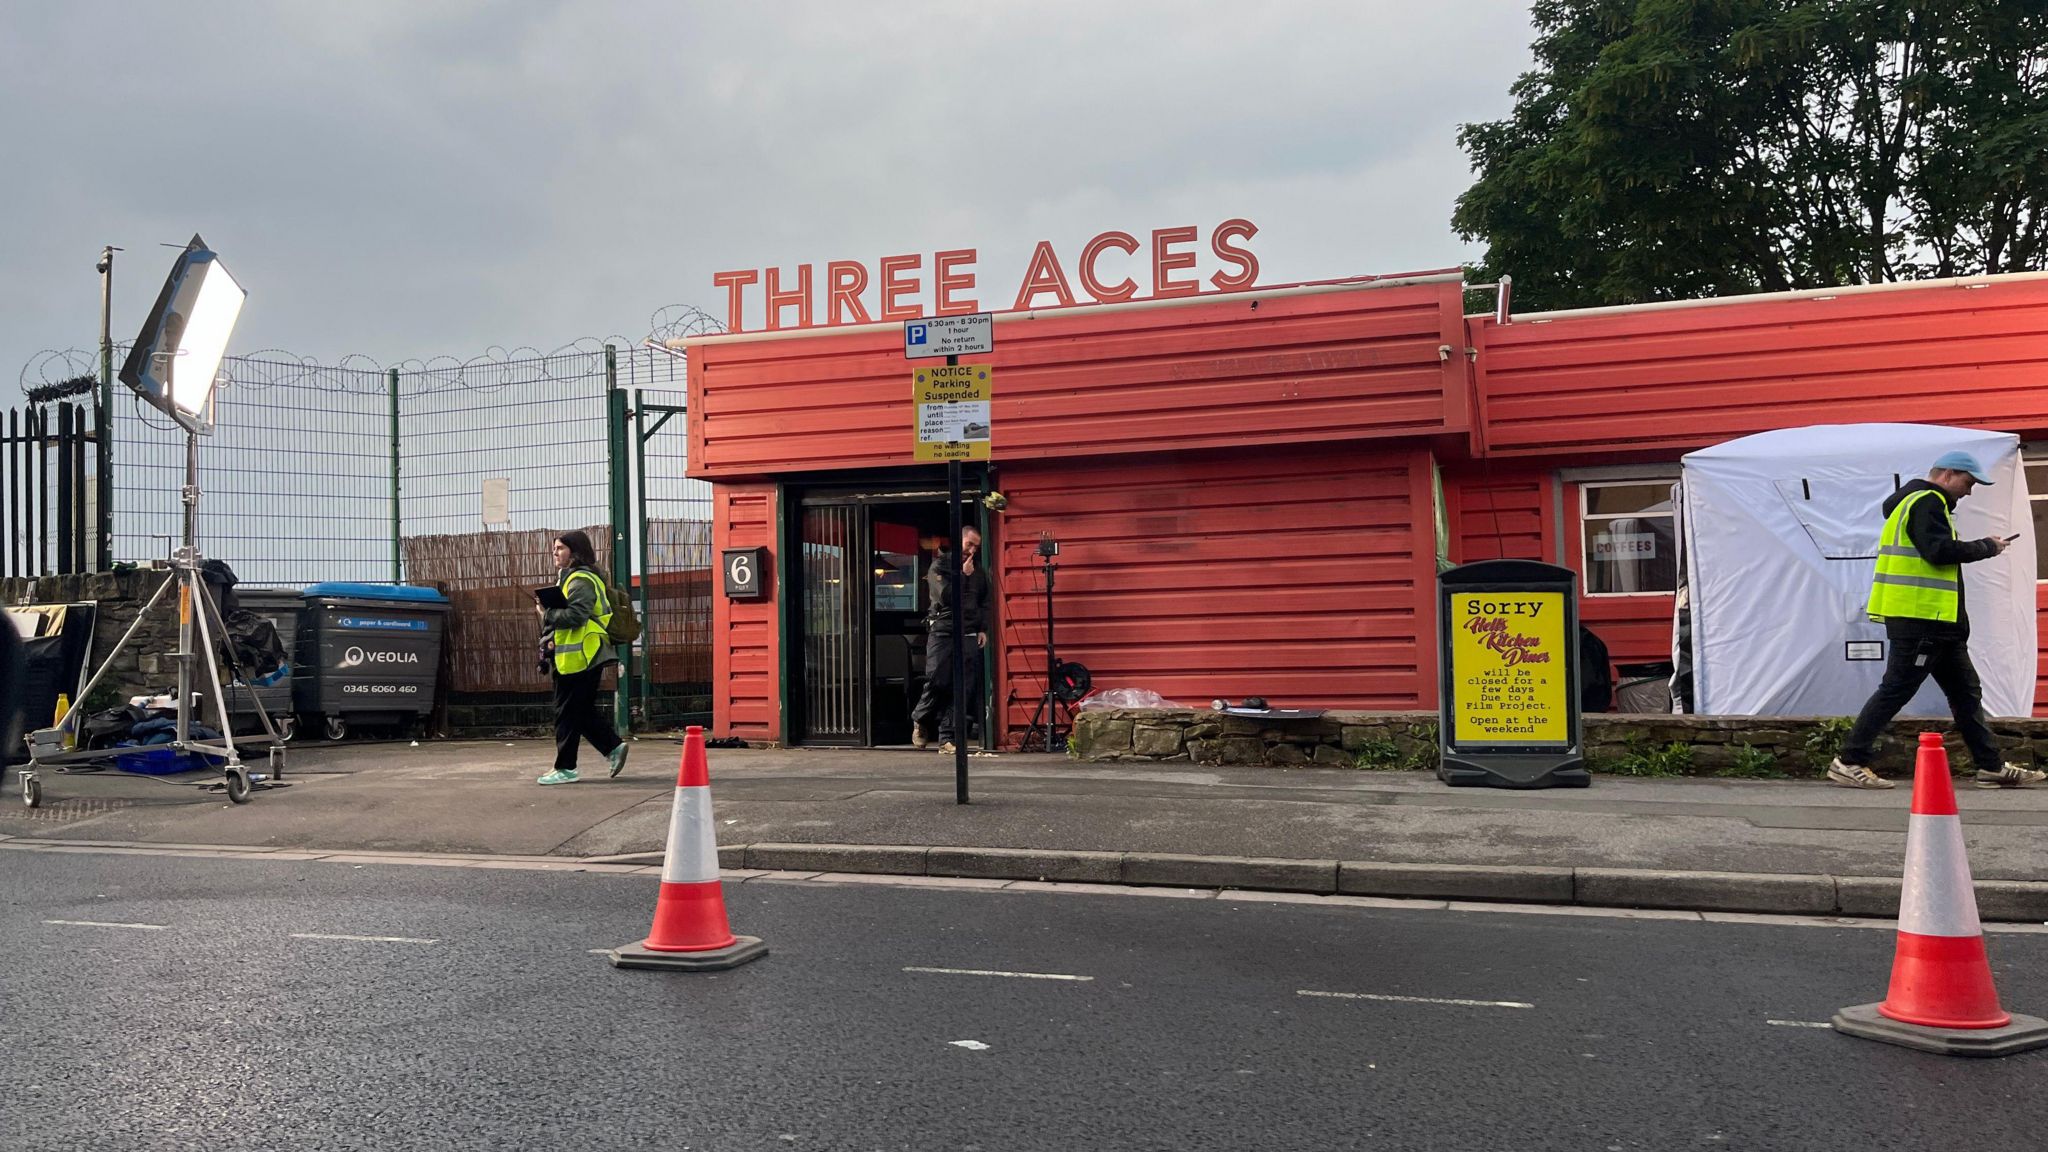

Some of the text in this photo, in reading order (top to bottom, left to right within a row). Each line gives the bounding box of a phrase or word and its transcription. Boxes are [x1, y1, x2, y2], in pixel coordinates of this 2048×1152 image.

[713, 218, 1259, 333] THREE ACES
[912, 326, 923, 344] P
[932, 367, 972, 377] NOTICE
[933, 379, 970, 388] Parking
[925, 390, 979, 401] Suspended
[731, 556, 751, 584] 6
[1468, 600, 1543, 617] Sorry
[1478, 632, 1541, 653] Kitchen
[366, 652, 418, 663] VEOLIA
[1502, 647, 1551, 667] Diner
[1508, 685, 1534, 694] days
[1500, 702, 1551, 711] Project.
[1470, 717, 1498, 726] Open
